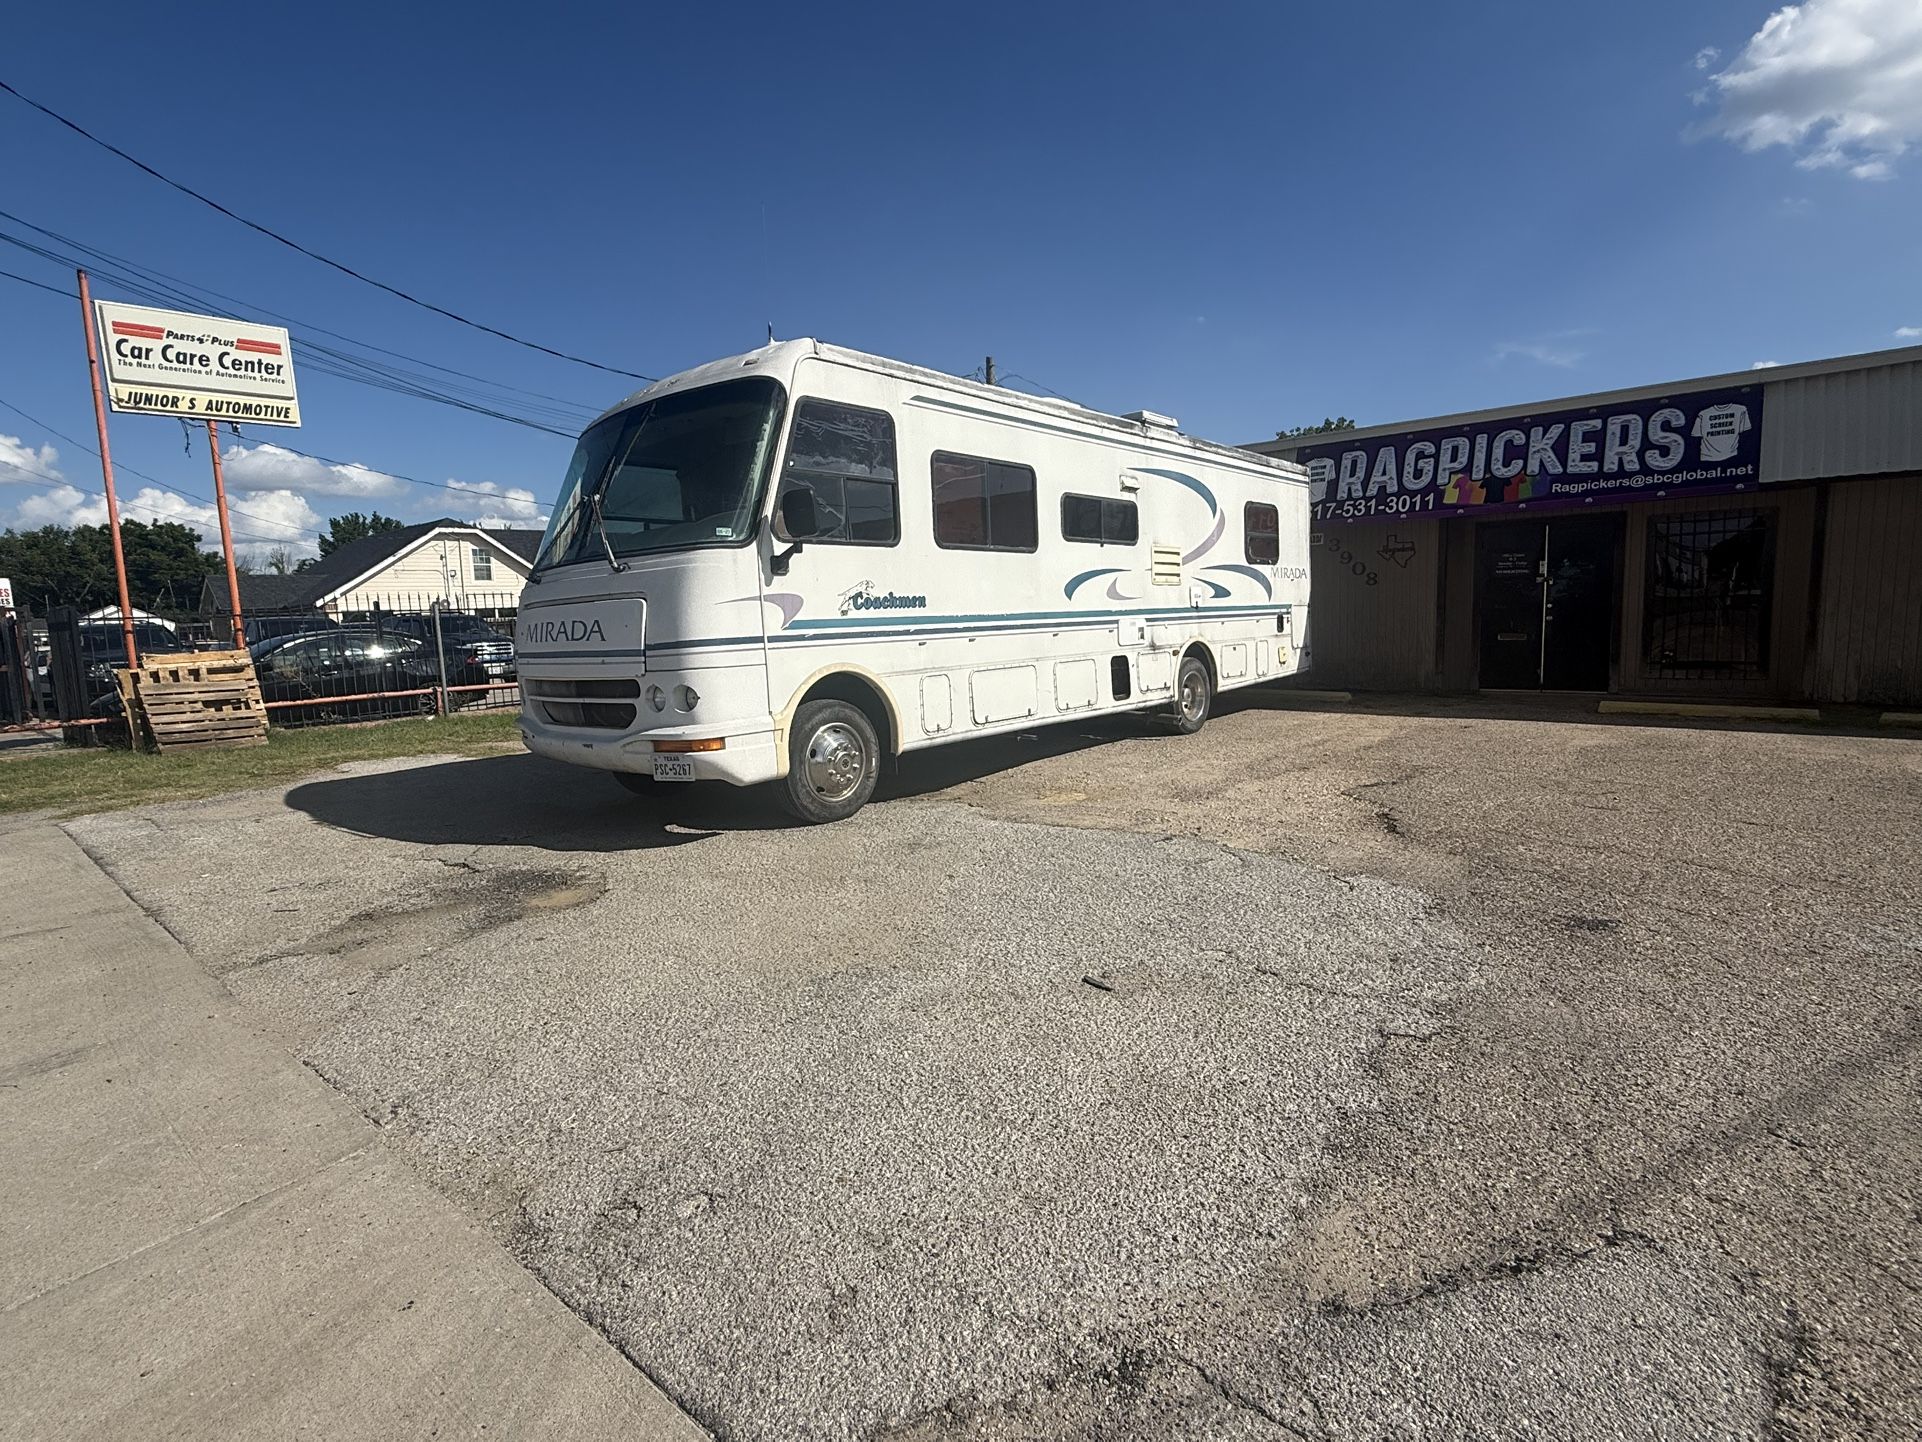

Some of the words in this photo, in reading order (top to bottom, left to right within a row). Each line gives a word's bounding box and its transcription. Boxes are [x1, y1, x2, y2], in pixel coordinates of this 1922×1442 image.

[165, 329, 196, 342] PARTS
[210, 336, 236, 348] PLUS
[115, 338, 153, 361] Car
[161, 343, 211, 367] Care
[217, 351, 285, 377] Center
[117, 358, 134, 367] The
[136, 360, 156, 370] Next
[158, 363, 203, 375] Generation
[215, 370, 257, 381] Automotive
[260, 375, 286, 385] Service
[204, 399, 291, 419] AUTOMOTIVE
[1709, 412, 1735, 421] CUSTOM
[1706, 428, 1736, 438] PRINTING
[1710, 421, 1734, 429] SCREEN
[1335, 408, 1687, 501] RAGPICKERS
[1551, 464, 1755, 494] Ragpickers@sbcglobal.net
[1310, 493, 1435, 521] 17-531-3011
[1270, 566, 1308, 580] MIRADA
[851, 590, 928, 611] Coachmen
[526, 619, 607, 644] MIRADA
